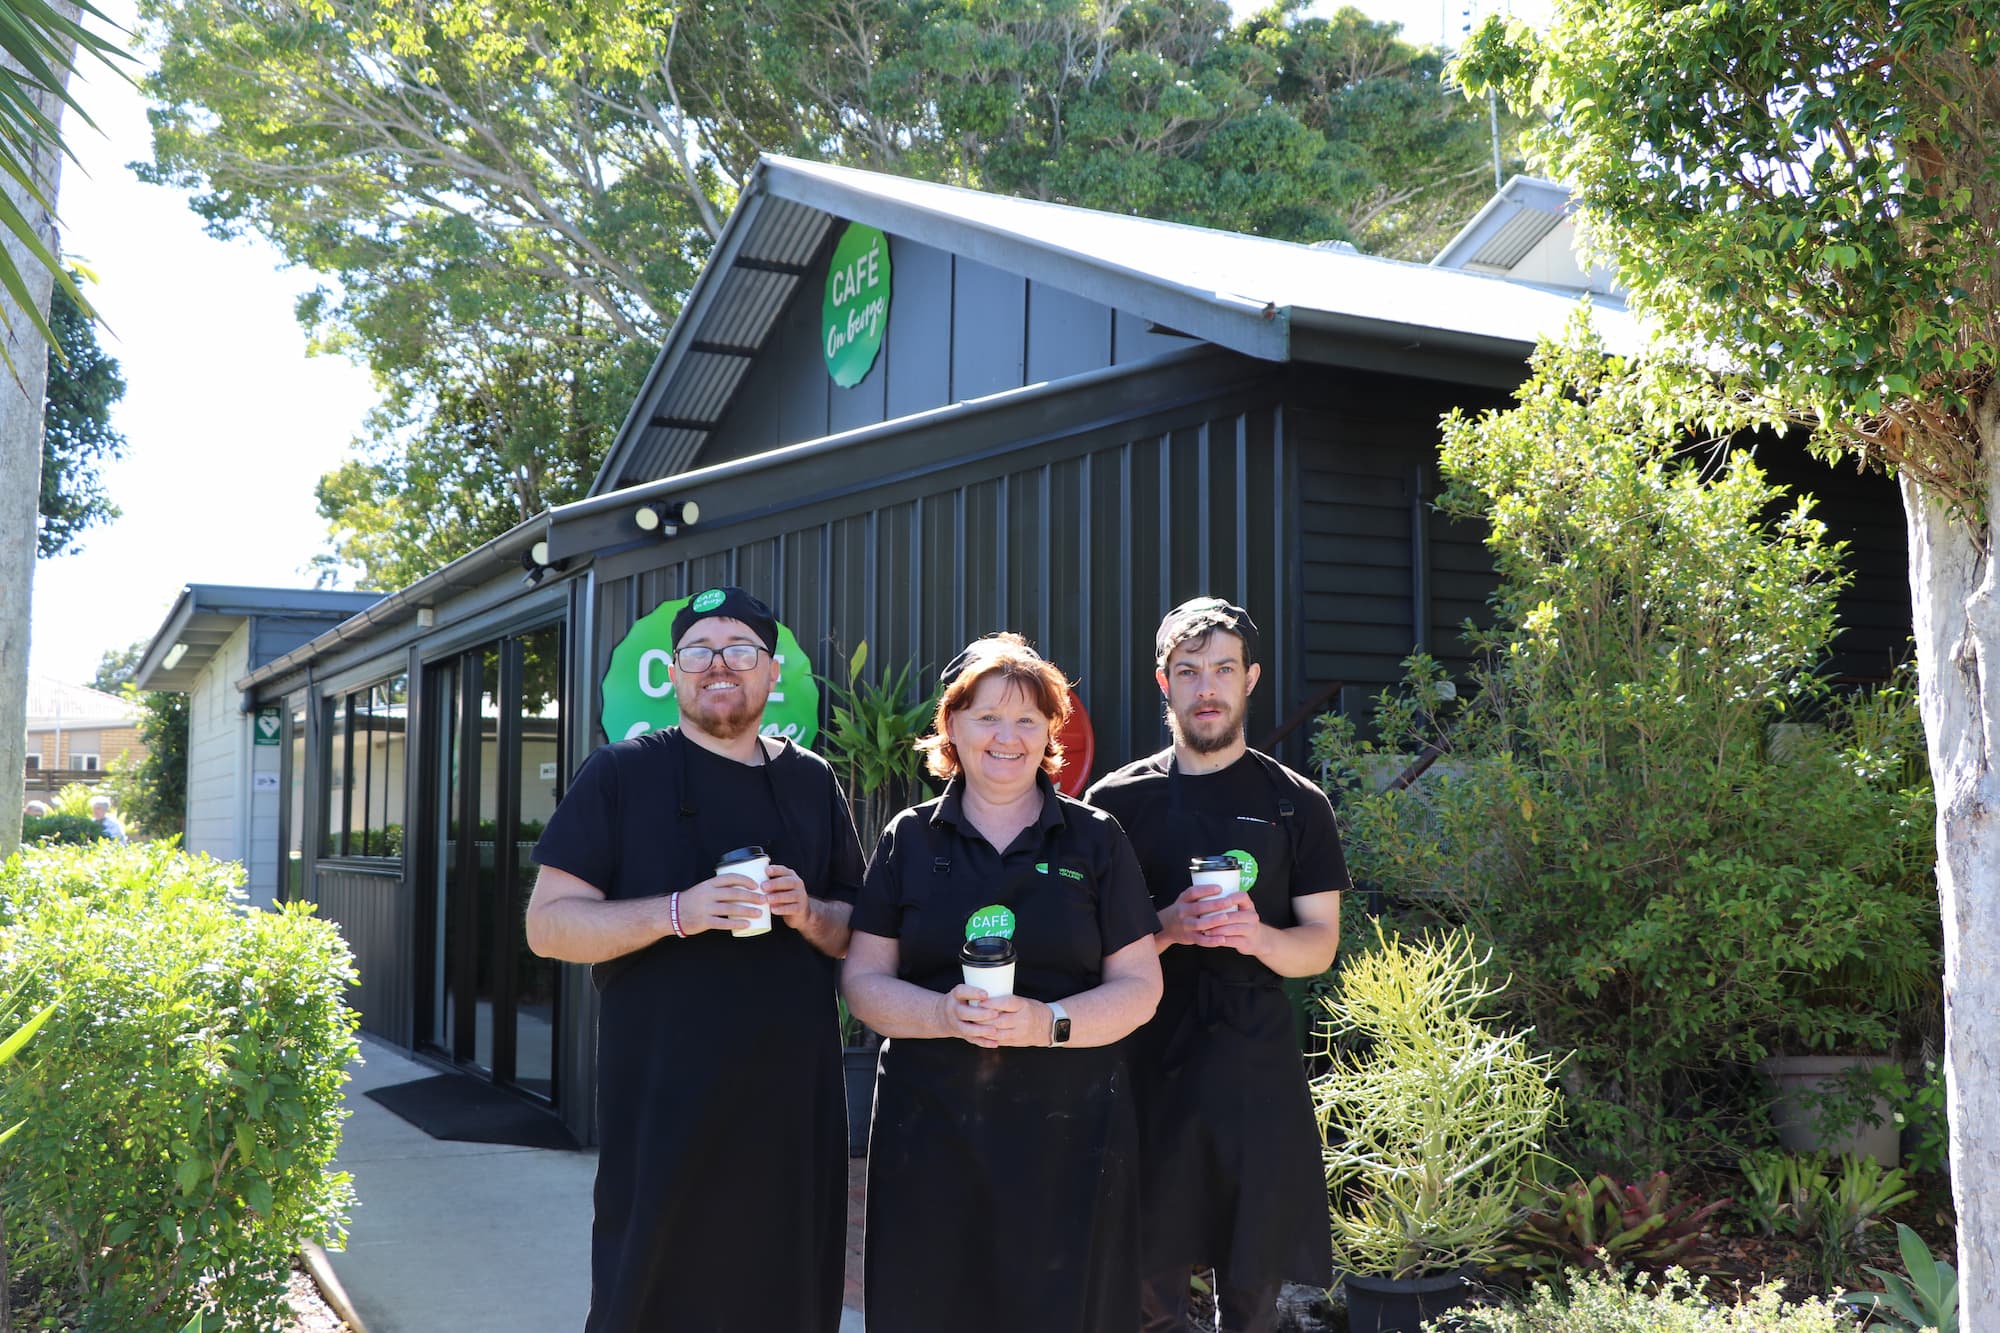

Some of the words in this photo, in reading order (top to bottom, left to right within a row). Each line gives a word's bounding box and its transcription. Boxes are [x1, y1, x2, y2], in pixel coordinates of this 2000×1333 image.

[832, 236, 880, 307] CAFÉ
[827, 325, 846, 358] On
[847, 296, 885, 342] George
[972, 911, 1009, 928] CAFÉ
